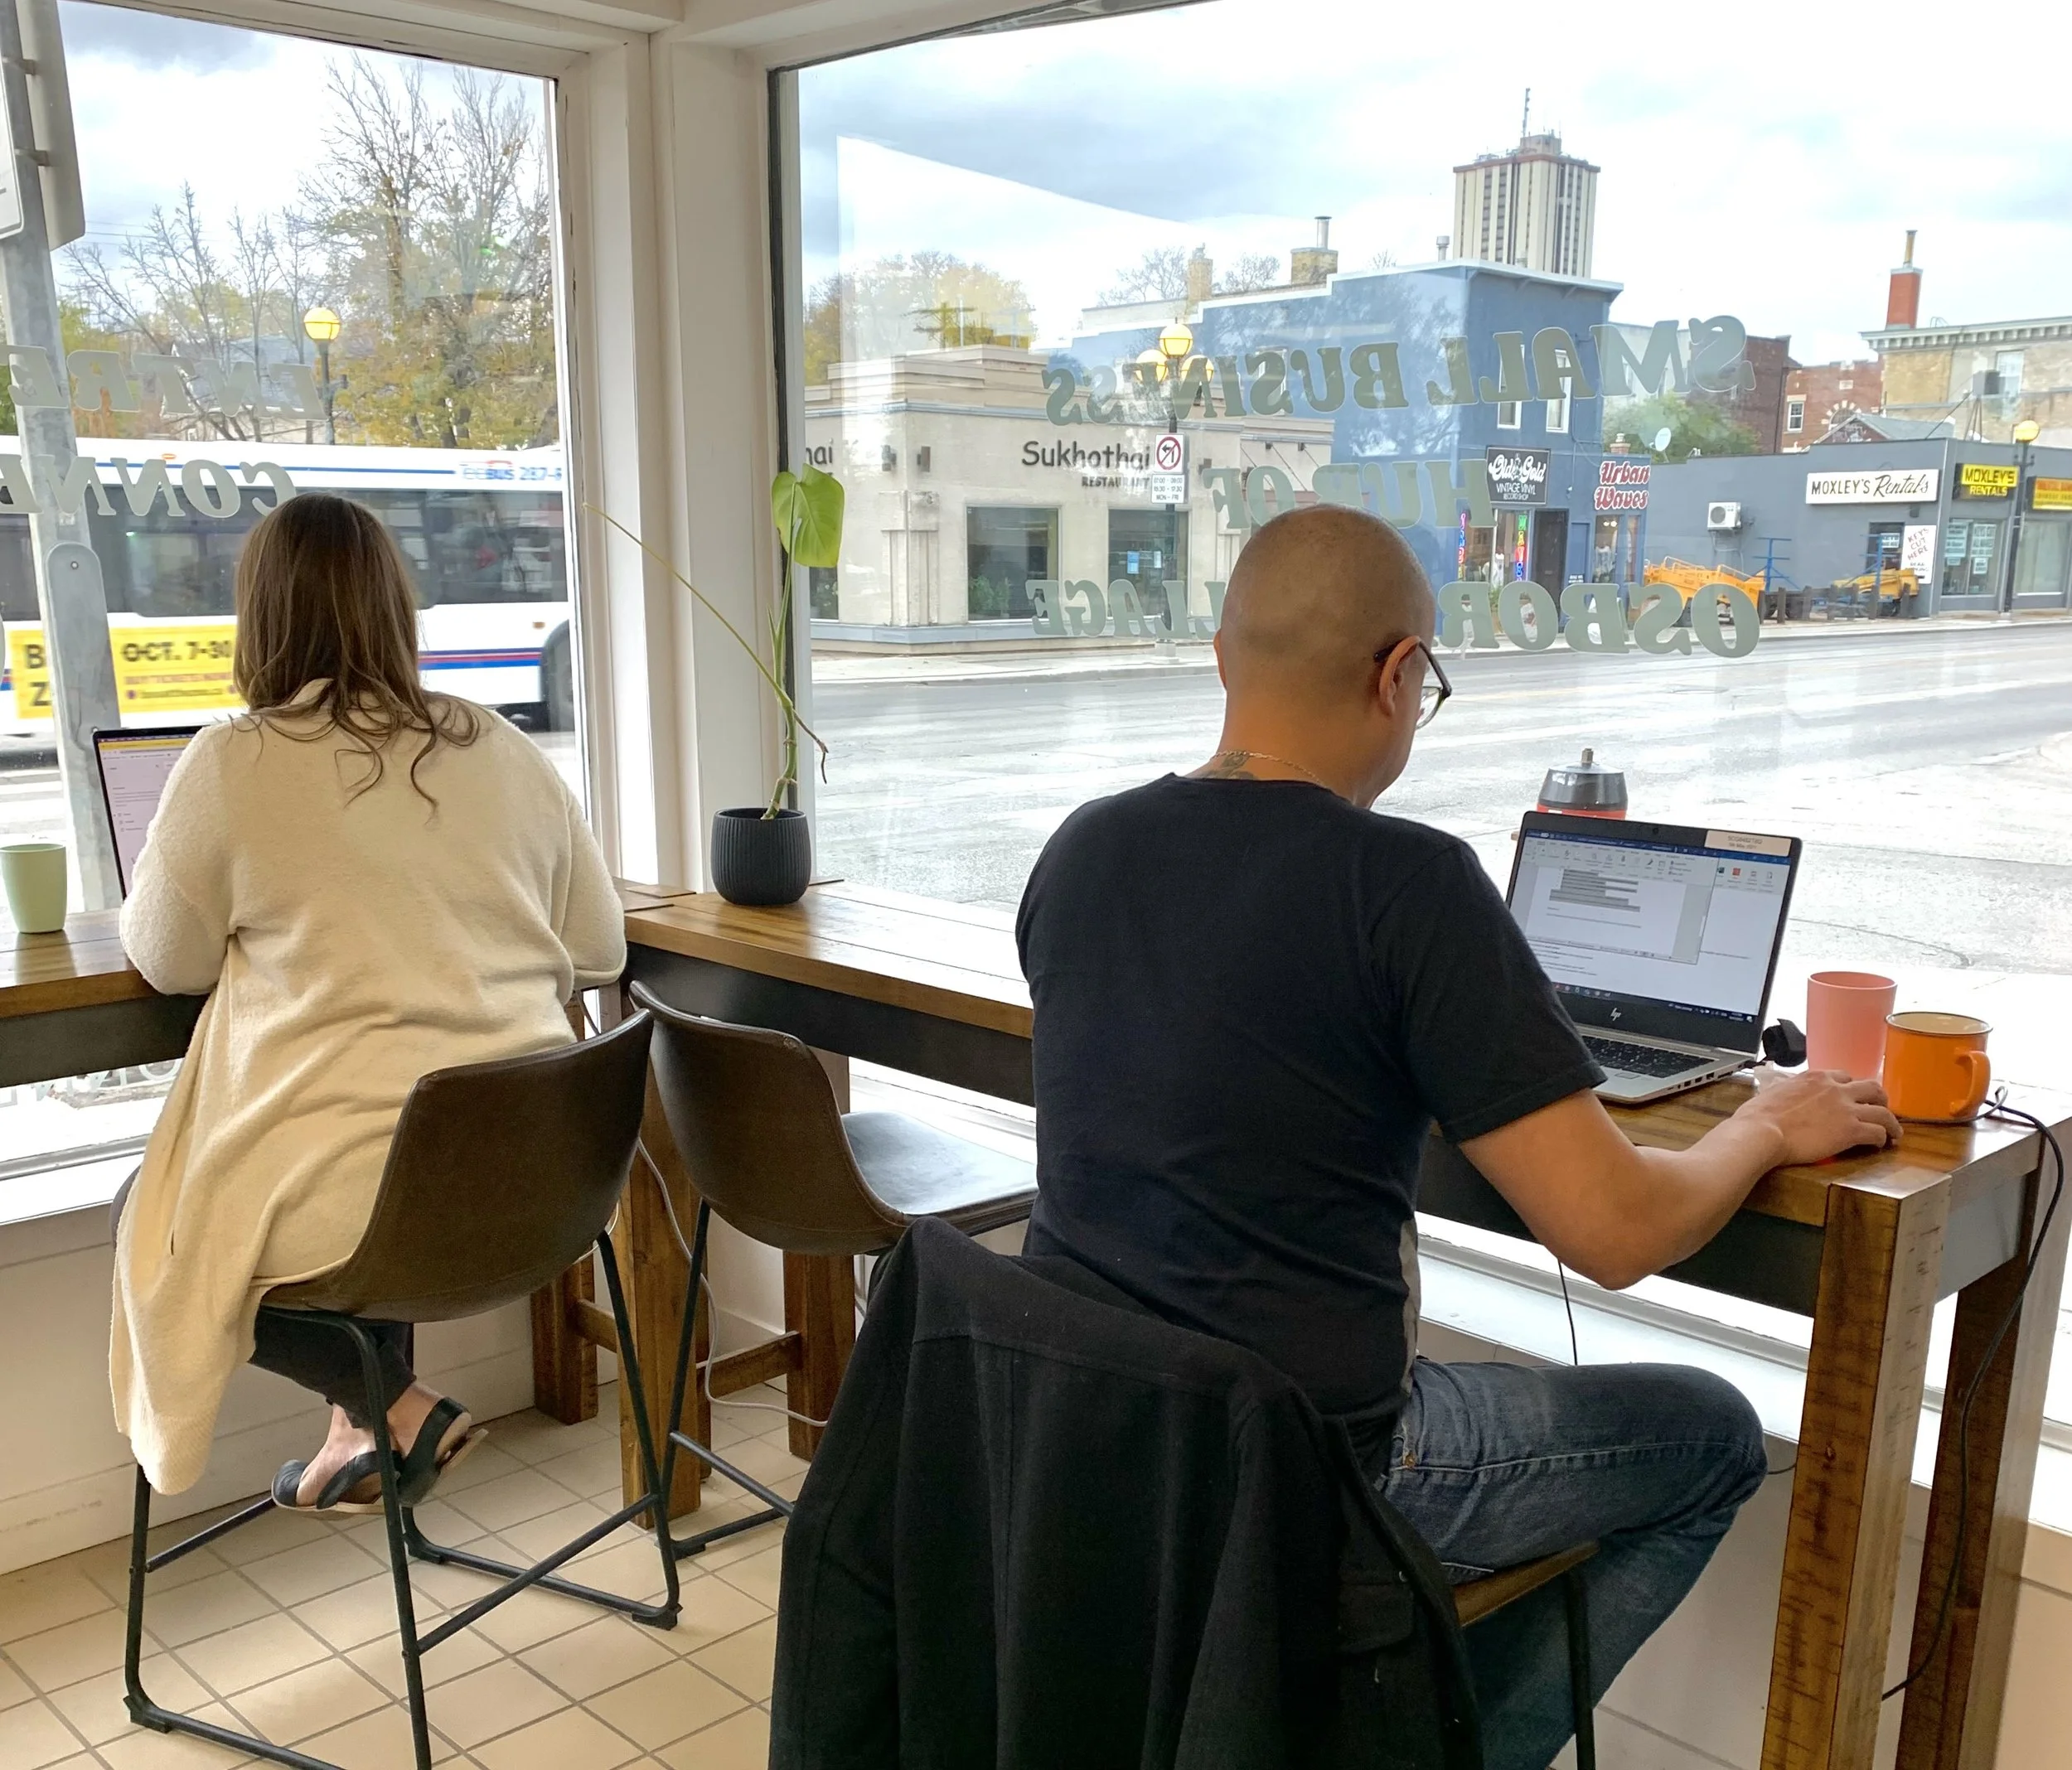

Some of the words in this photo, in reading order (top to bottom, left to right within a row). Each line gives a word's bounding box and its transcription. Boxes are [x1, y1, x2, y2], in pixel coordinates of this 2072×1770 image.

[1022, 439, 1150, 471] Sukhothai
[1519, 456, 1547, 482] Gold
[1600, 461, 1651, 485] Urban
[1965, 467, 2015, 484] MOXLEY'S
[1496, 482, 1520, 493] VINTAGE
[1812, 479, 1871, 495] MOXLEY'S
[1969, 485, 2007, 496] RENTALS
[1594, 486, 1649, 510] Waves
[1910, 537, 1926, 550] CUT
[1908, 545, 1928, 560] HERE
[122, 642, 182, 662] OCT.
